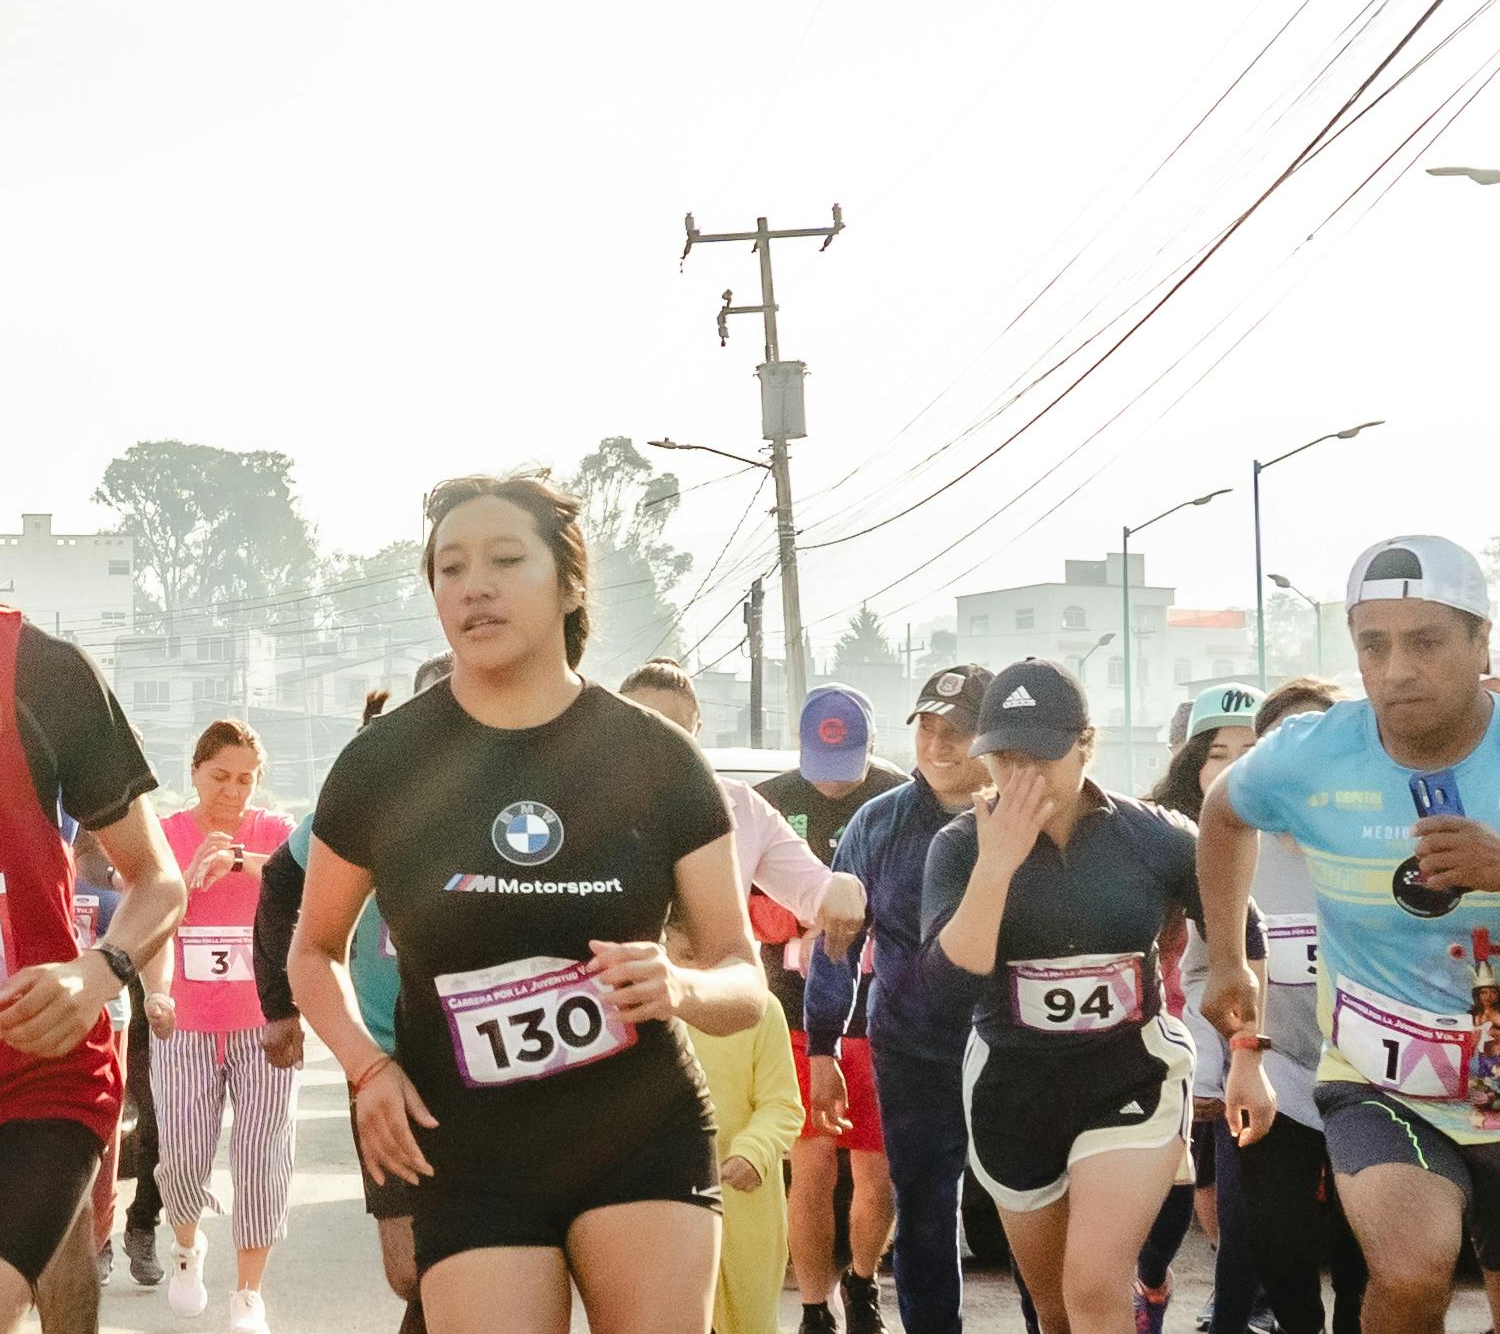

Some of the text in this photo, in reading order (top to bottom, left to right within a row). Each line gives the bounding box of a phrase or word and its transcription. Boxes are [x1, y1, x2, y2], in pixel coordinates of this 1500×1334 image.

[498, 877, 624, 897] Motorsport
[210, 951, 230, 975] 3
[1043, 984, 1115, 1023] 94
[475, 995, 603, 1071] 130
[1381, 1037, 1400, 1081] 1
